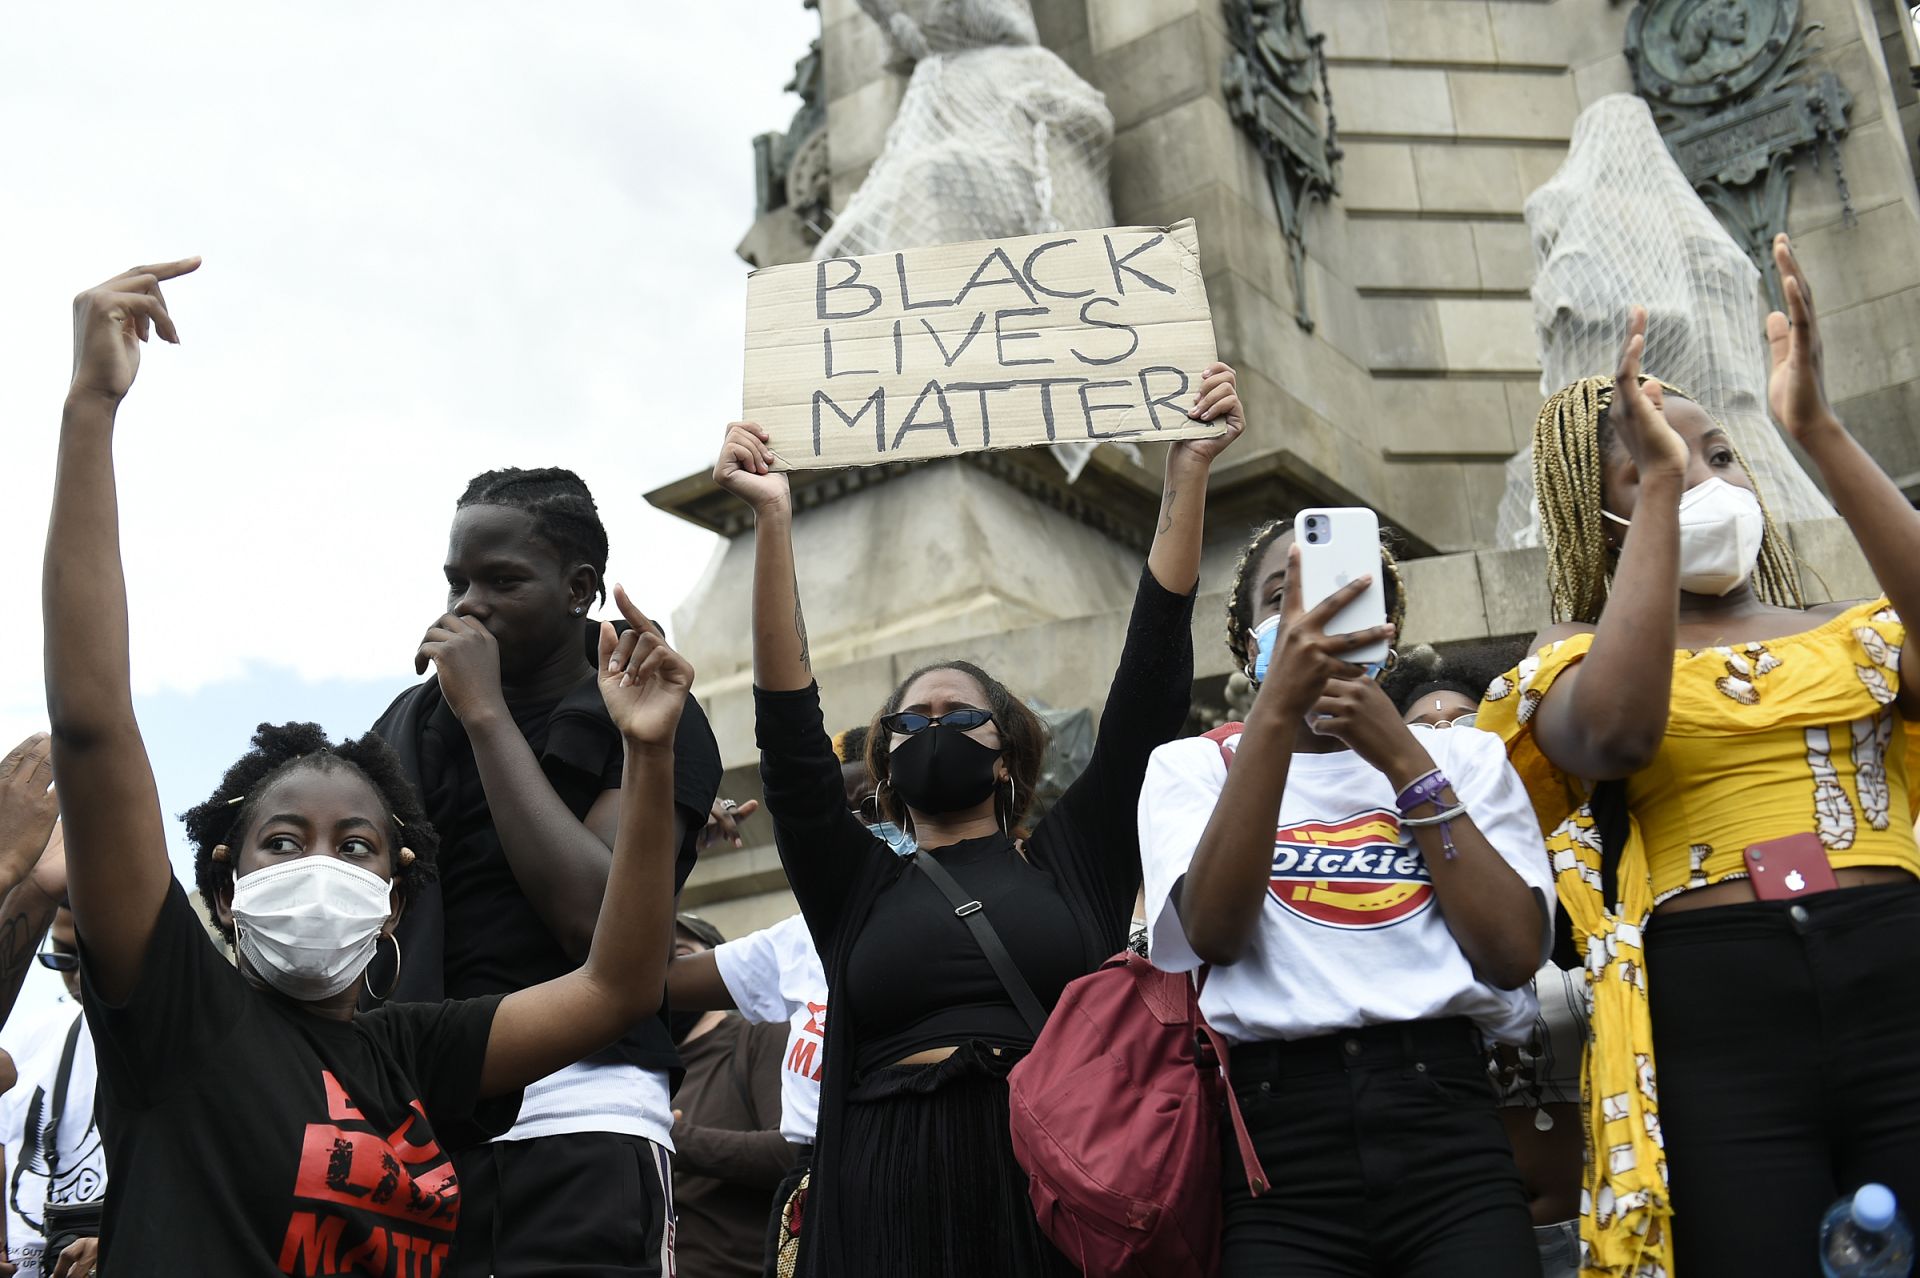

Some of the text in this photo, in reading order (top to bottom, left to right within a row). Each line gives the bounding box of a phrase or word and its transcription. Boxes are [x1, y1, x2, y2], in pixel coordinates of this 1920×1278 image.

[816, 233, 1177, 320] BLACK
[823, 297, 1139, 379] LIVES
[812, 365, 1214, 456] MATTER
